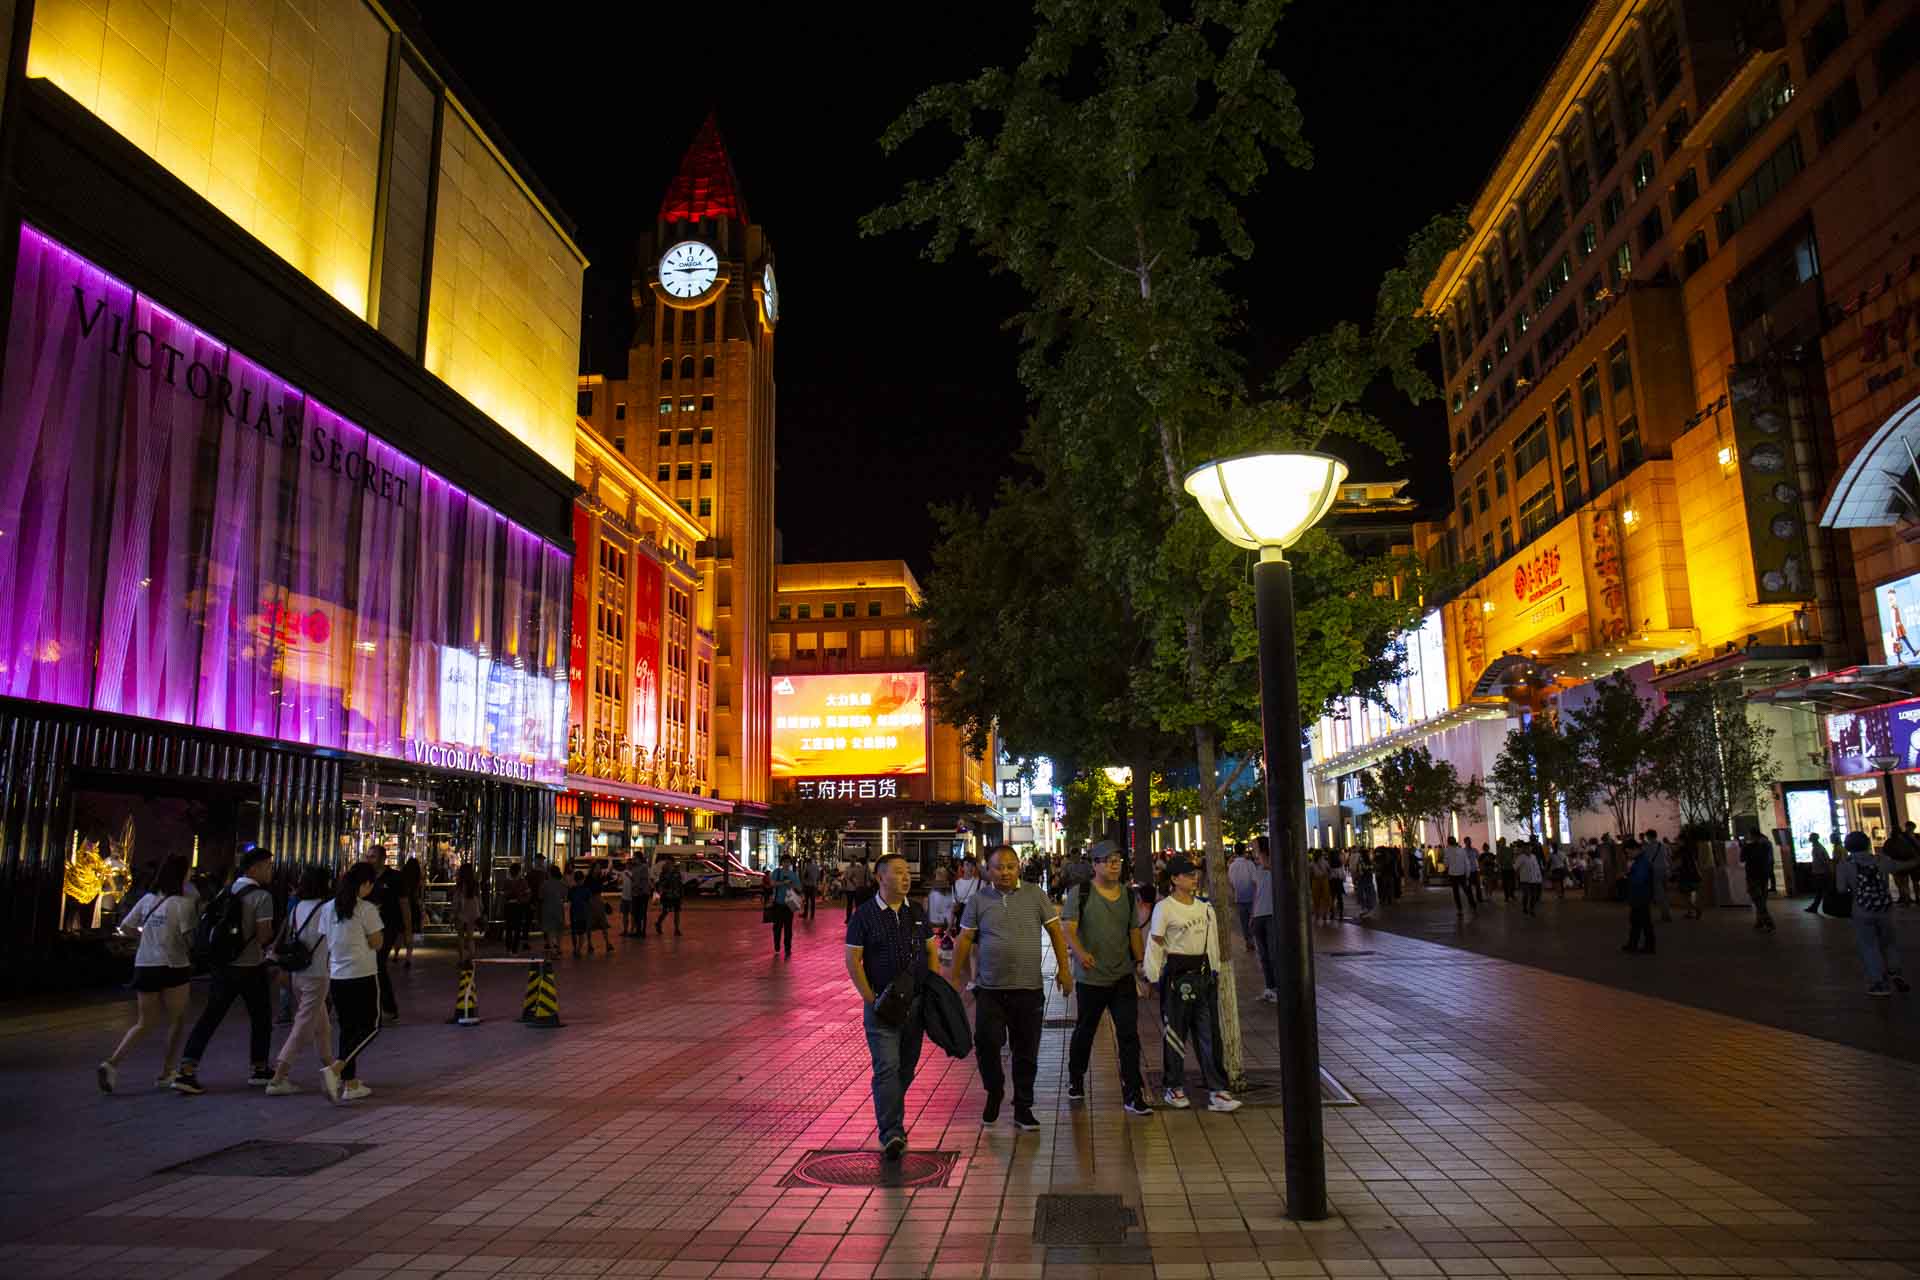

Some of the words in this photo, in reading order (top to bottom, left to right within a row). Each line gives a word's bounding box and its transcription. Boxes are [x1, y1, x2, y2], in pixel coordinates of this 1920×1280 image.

[72, 285, 298, 449] VICTORIA'S
[311, 427, 408, 507] SECRET
[414, 739, 487, 773] VICTORIA'S
[493, 755, 533, 781] SECRET
[798, 778, 897, 800] 王府井百货
